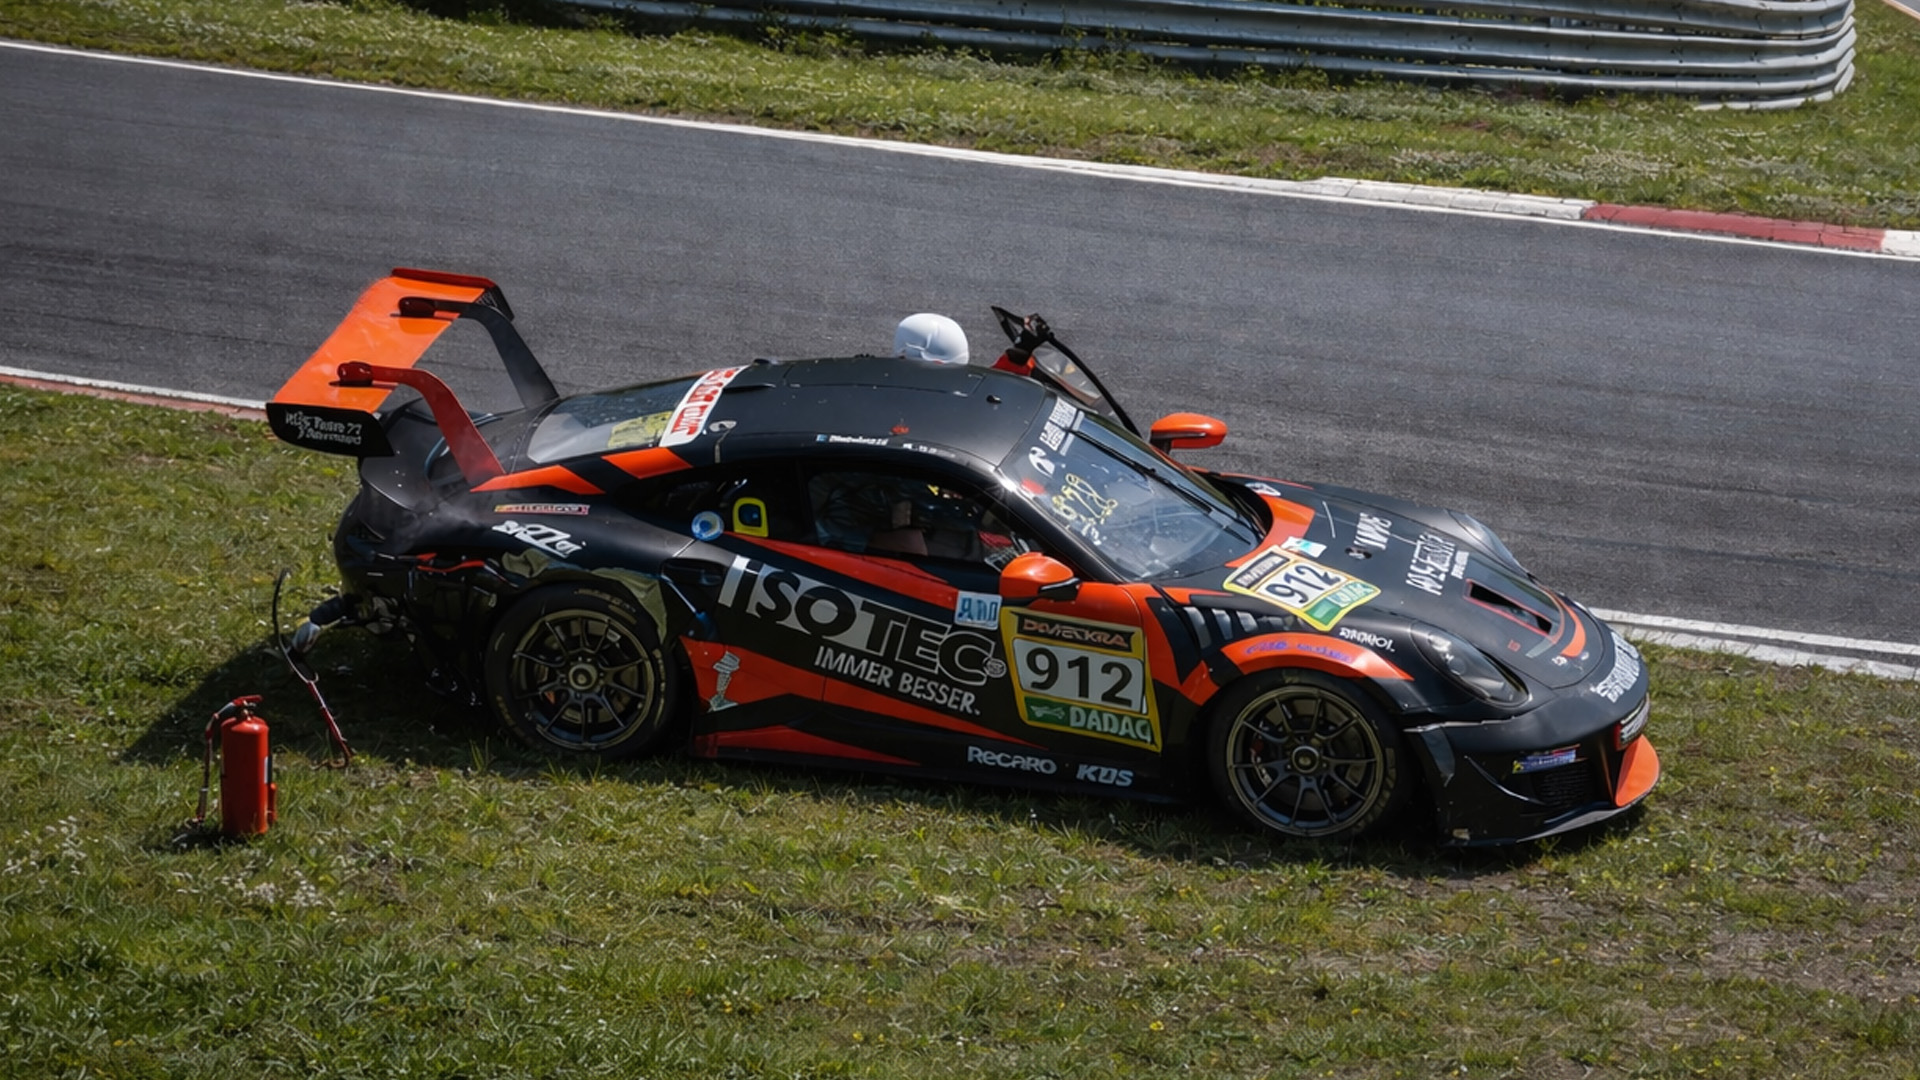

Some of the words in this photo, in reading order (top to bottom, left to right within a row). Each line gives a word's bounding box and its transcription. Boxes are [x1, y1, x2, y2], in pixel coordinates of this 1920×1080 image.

[1265, 564, 1342, 603] 912
[718, 554, 997, 686] ISOTEC
[814, 646, 893, 688] IMMER
[898, 672, 981, 715] BESSER.
[1025, 647, 1133, 708] 912
